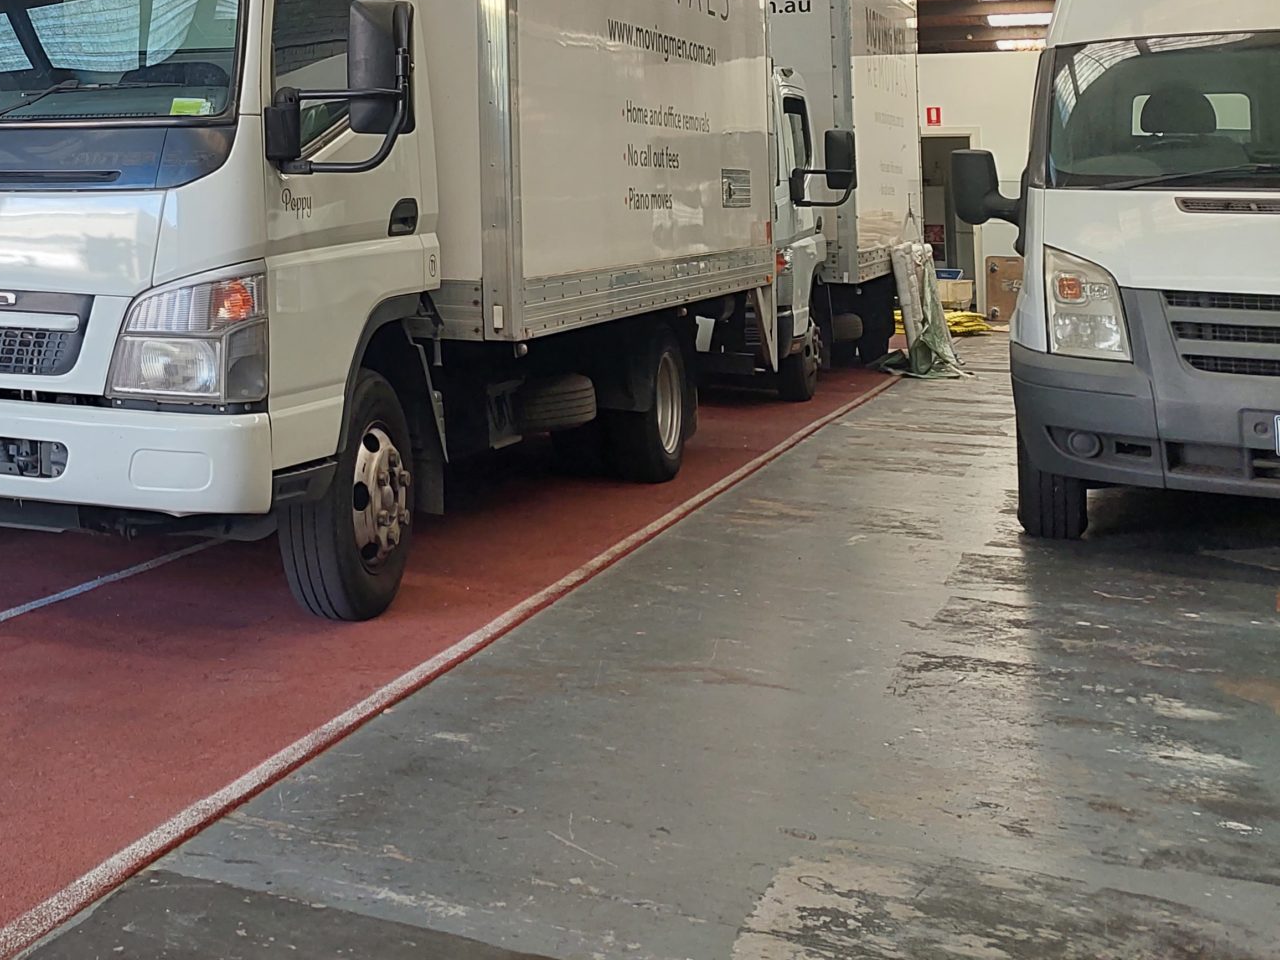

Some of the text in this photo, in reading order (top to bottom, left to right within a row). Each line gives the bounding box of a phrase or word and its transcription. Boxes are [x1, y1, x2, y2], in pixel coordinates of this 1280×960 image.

[607, 18, 717, 67] www.movingmen.com.au
[626, 99, 710, 133] Home and office removals
[627, 143, 680, 169] No call out fees
[628, 187, 673, 211] Piano moves
